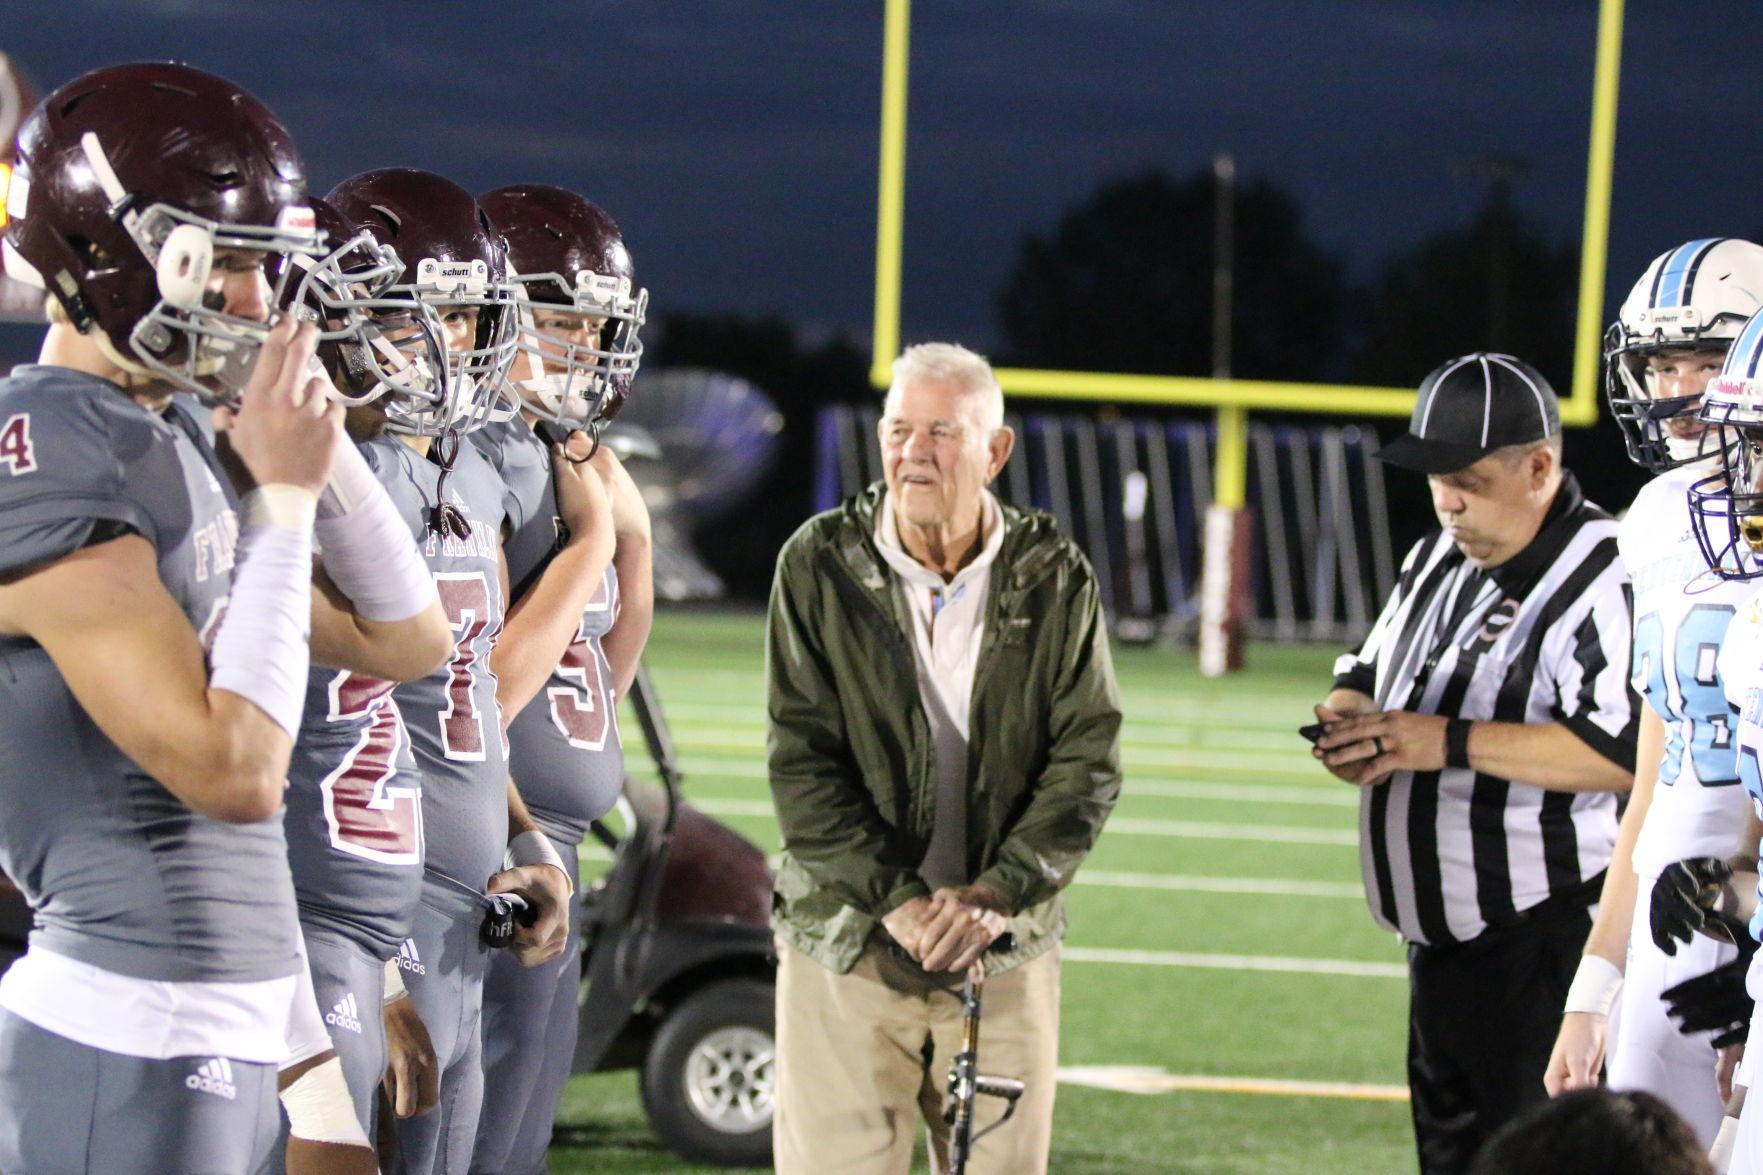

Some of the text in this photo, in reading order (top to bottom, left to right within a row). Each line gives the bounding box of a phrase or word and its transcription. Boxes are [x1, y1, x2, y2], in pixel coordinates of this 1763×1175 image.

[441, 268, 469, 277] schutt
[0, 412, 38, 476] 4
[433, 571, 509, 761] 7
[320, 668, 425, 865] 2
[391, 952, 426, 975] didas
[325, 1013, 362, 1034] adidas
[185, 1074, 237, 1100] adidas
